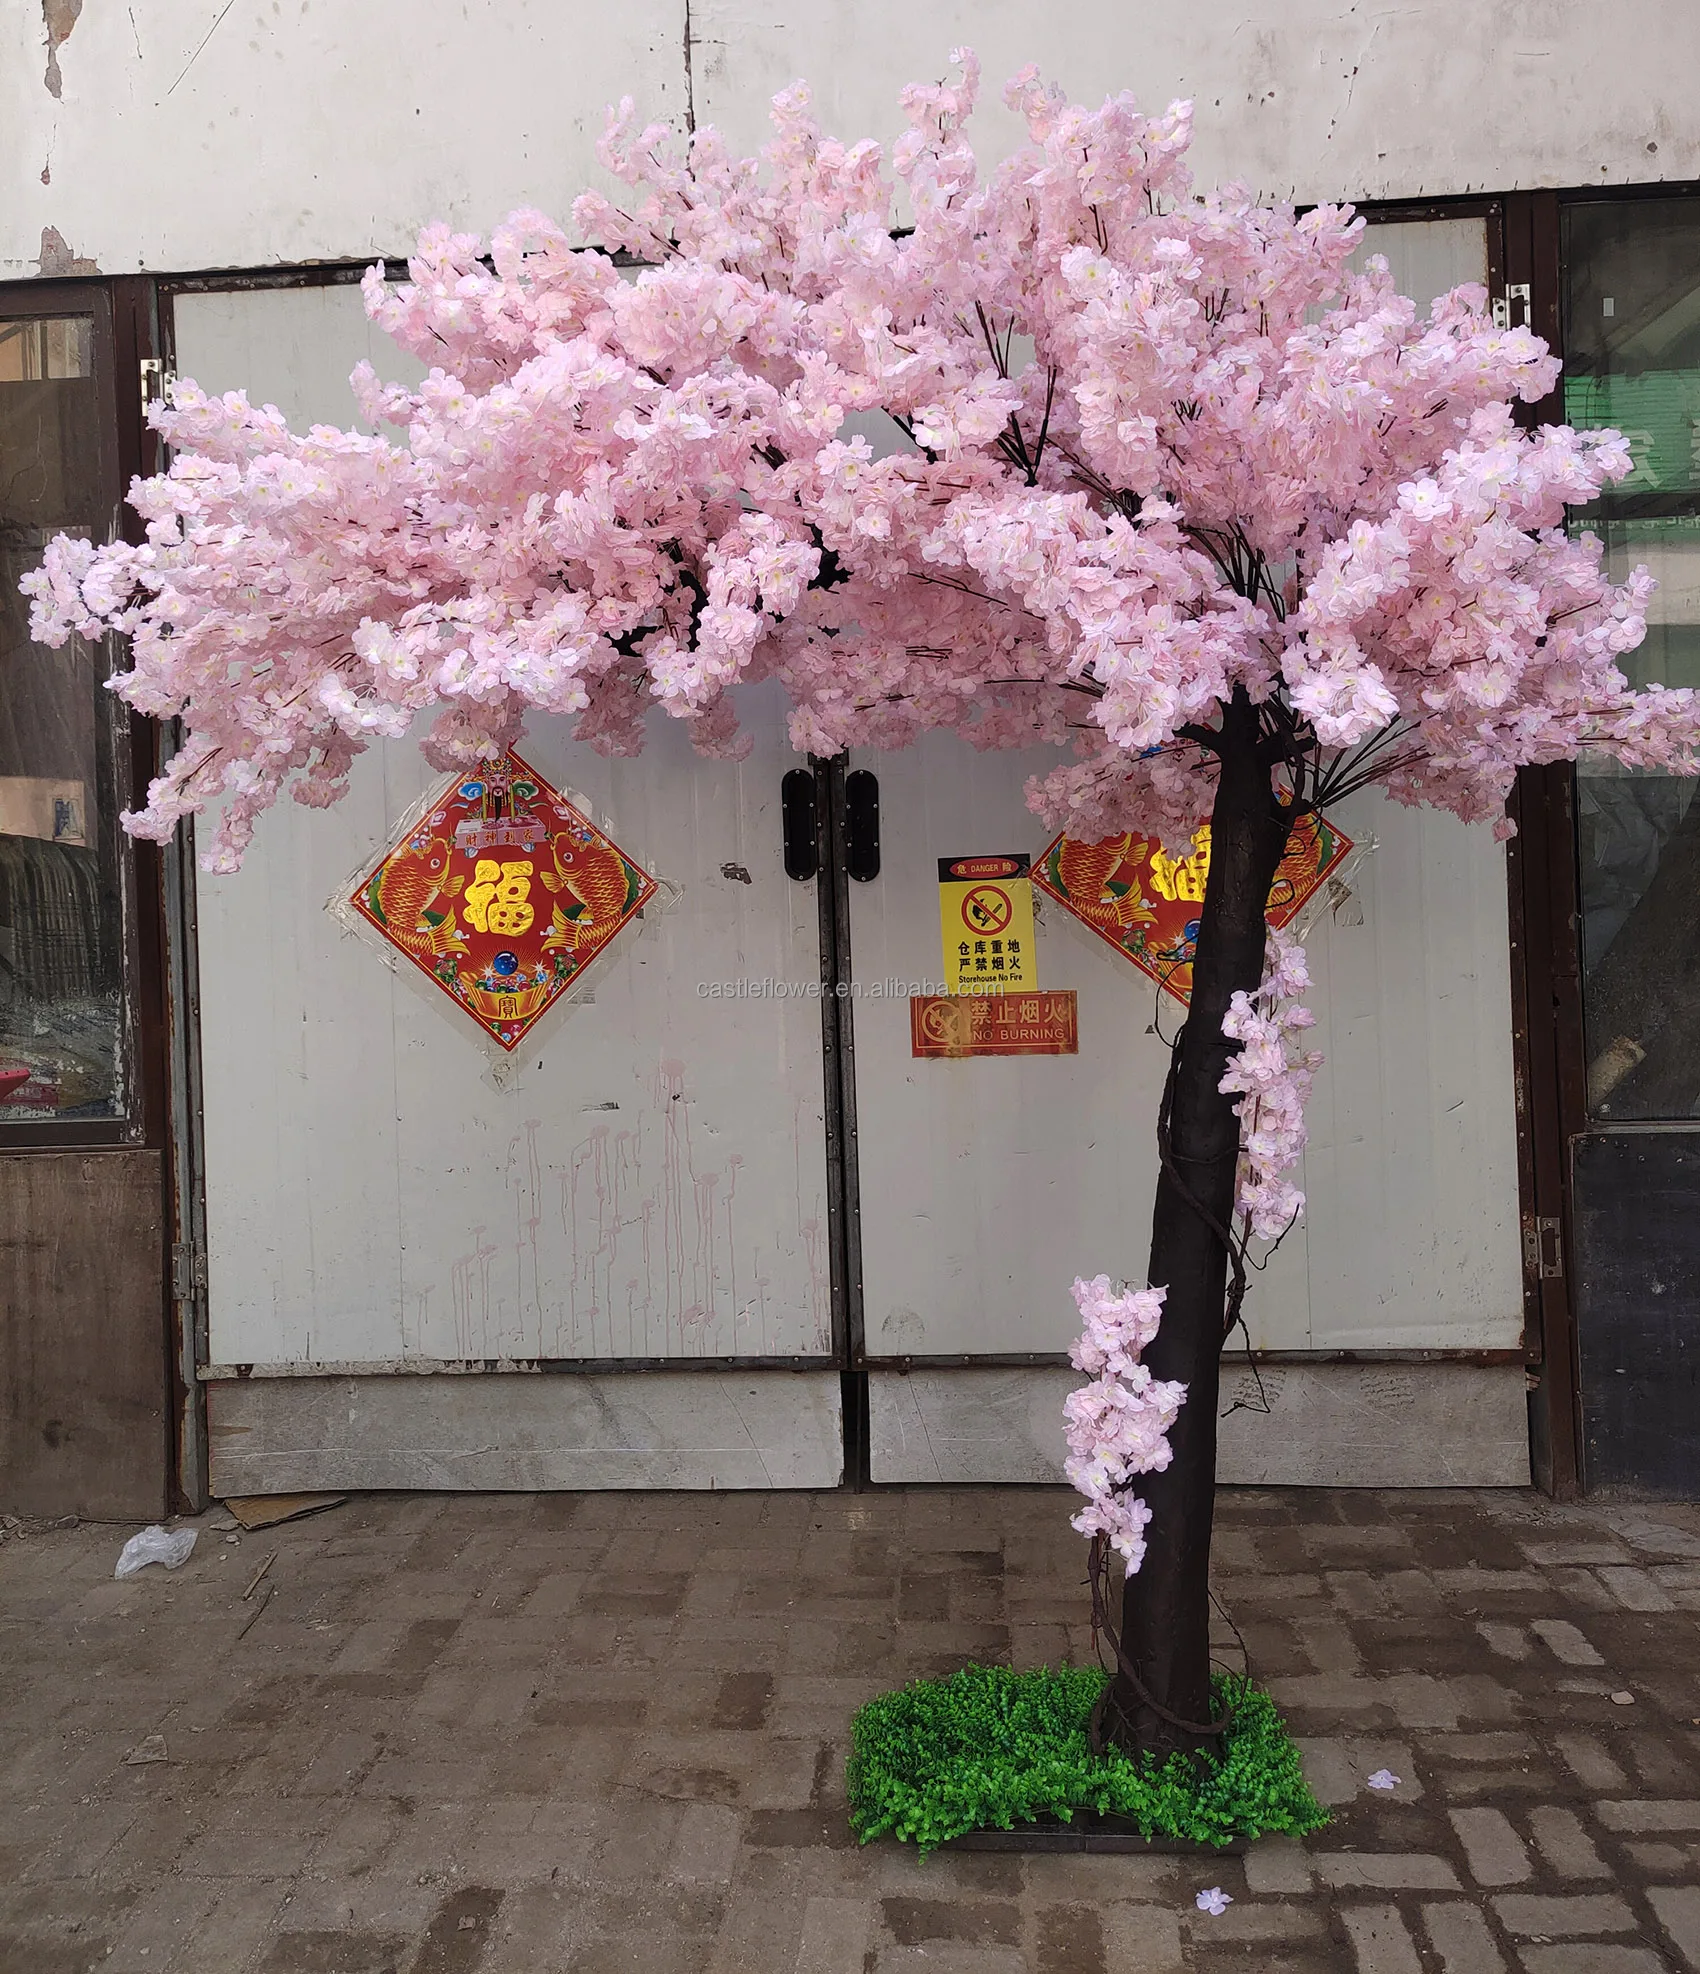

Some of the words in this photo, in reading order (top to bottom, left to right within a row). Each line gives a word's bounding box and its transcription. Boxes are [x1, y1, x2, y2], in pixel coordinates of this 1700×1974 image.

[971, 865, 999, 873] DANGER
[462, 859, 535, 937] 福
[958, 939, 1021, 956] 仓库重地
[959, 955, 1021, 972] 严禁烟火
[958, 974, 997, 984] Storehouse
[998, 973, 1008, 982] No
[1009, 972, 1023, 981] Fire
[971, 999, 1065, 1025] 禁止烟火
[973, 1030, 994, 1041] NO
[1000, 1028, 1065, 1041] BURNING
